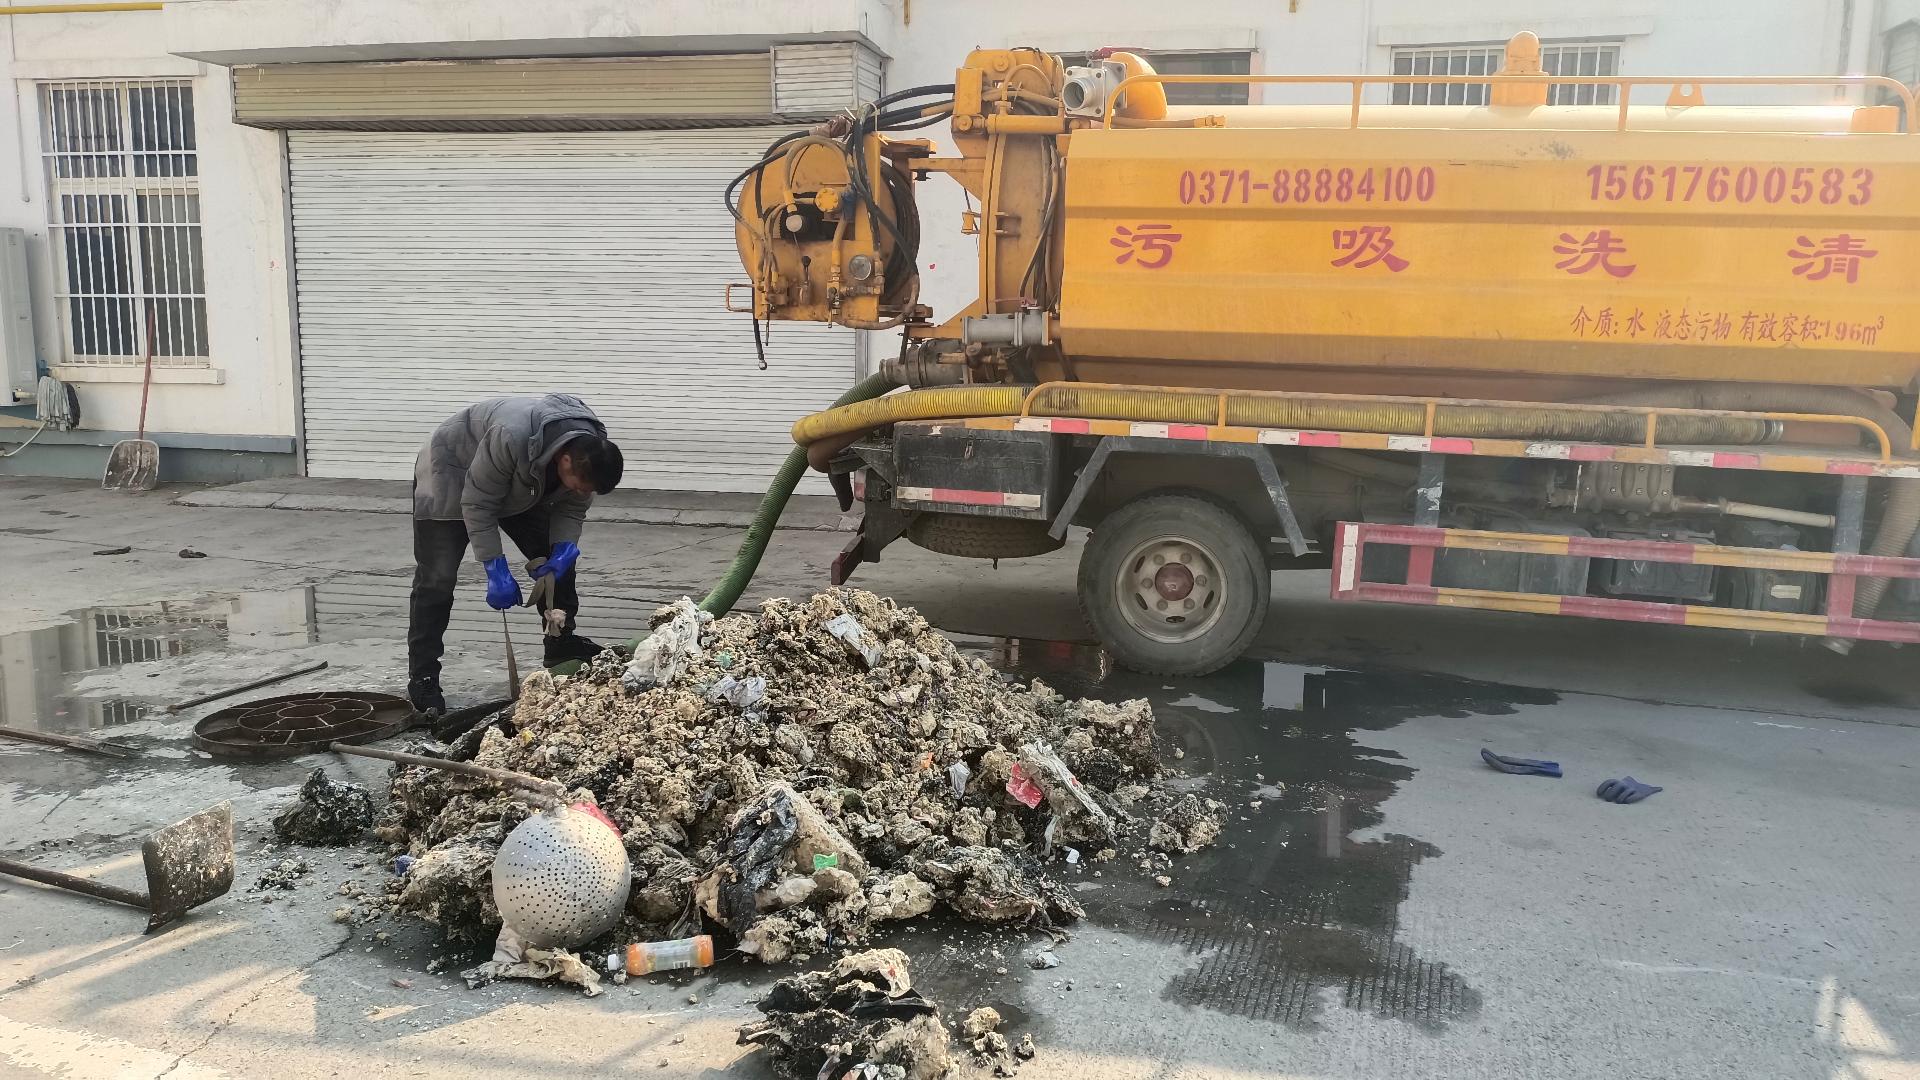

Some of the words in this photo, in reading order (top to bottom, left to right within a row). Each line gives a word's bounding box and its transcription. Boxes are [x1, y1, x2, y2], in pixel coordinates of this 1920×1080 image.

[1179, 166, 1435, 204] 0371-88884100
[1586, 165, 1874, 206] 15617600583
[1109, 224, 1182, 269] 污
[1330, 225, 1410, 272] 吸
[1553, 230, 1636, 278] 洗
[1787, 234, 1878, 284] 清
